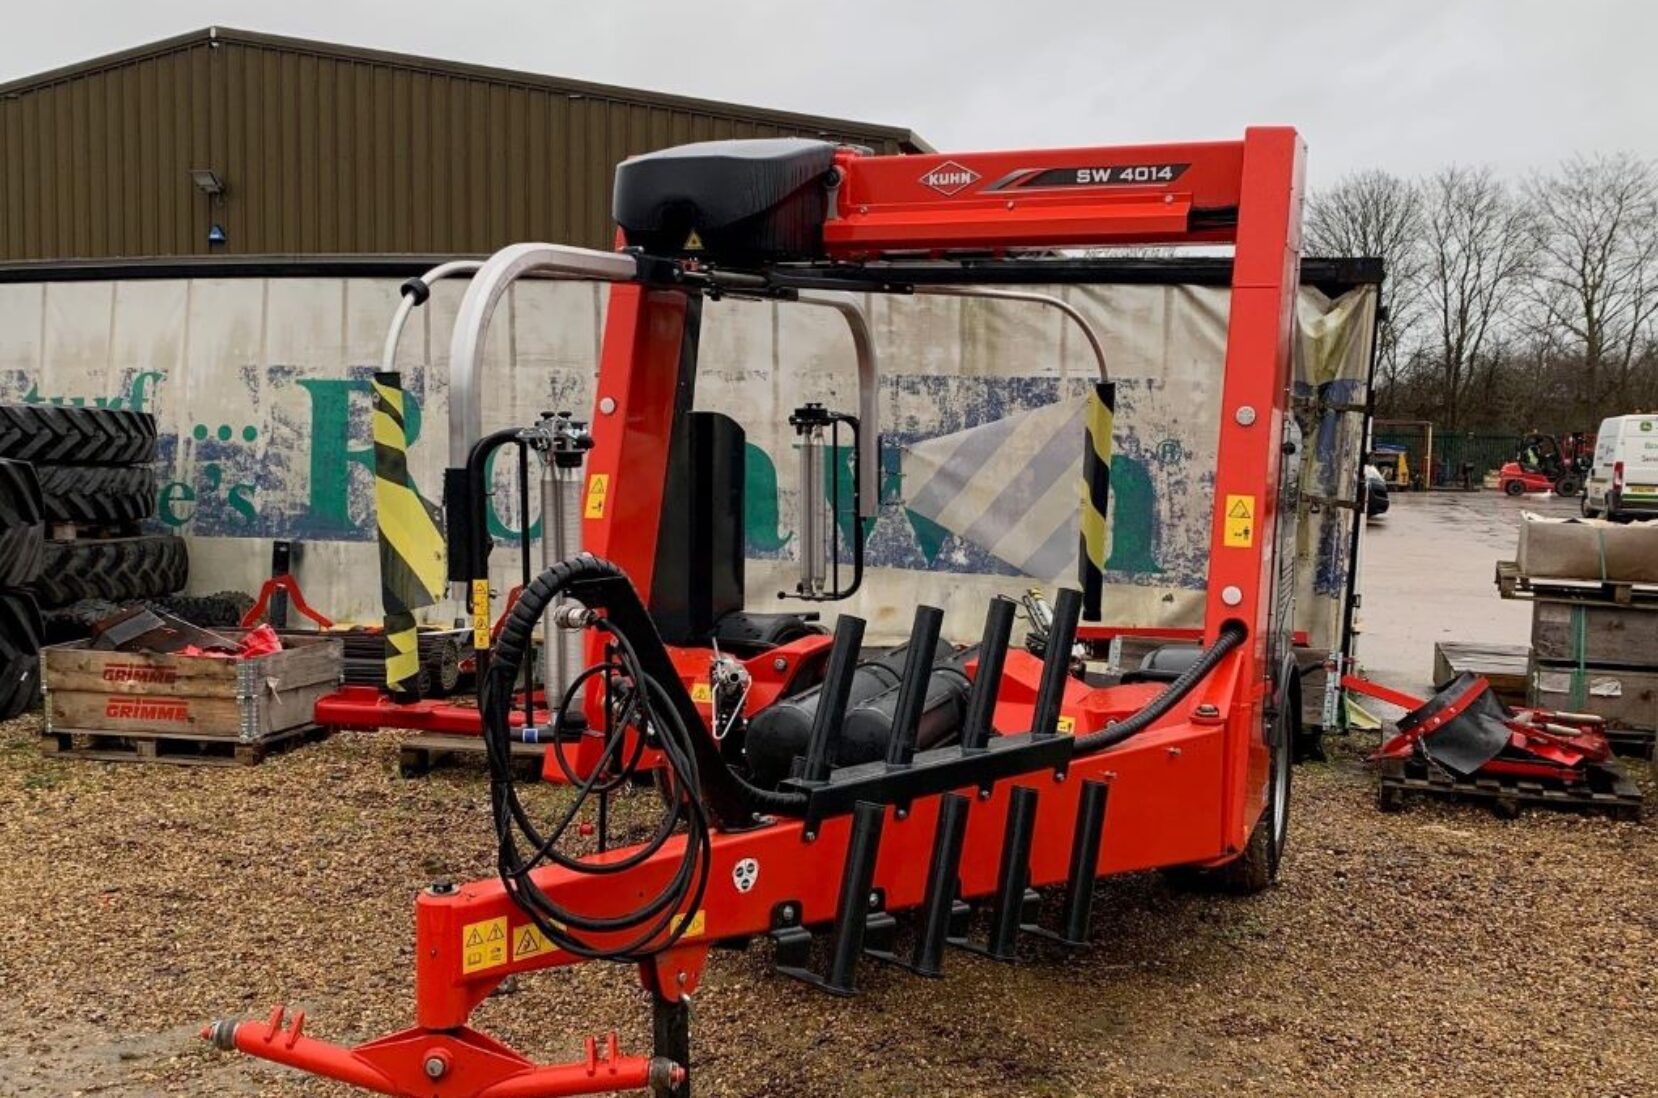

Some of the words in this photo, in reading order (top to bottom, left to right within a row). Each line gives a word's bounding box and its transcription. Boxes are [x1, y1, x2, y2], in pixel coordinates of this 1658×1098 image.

[928, 171, 971, 186] KUHN
[1076, 168, 1112, 184] SW
[1119, 166, 1174, 181] 4014
[103, 667, 177, 684] GRIMME
[105, 703, 189, 722] GRIMME
